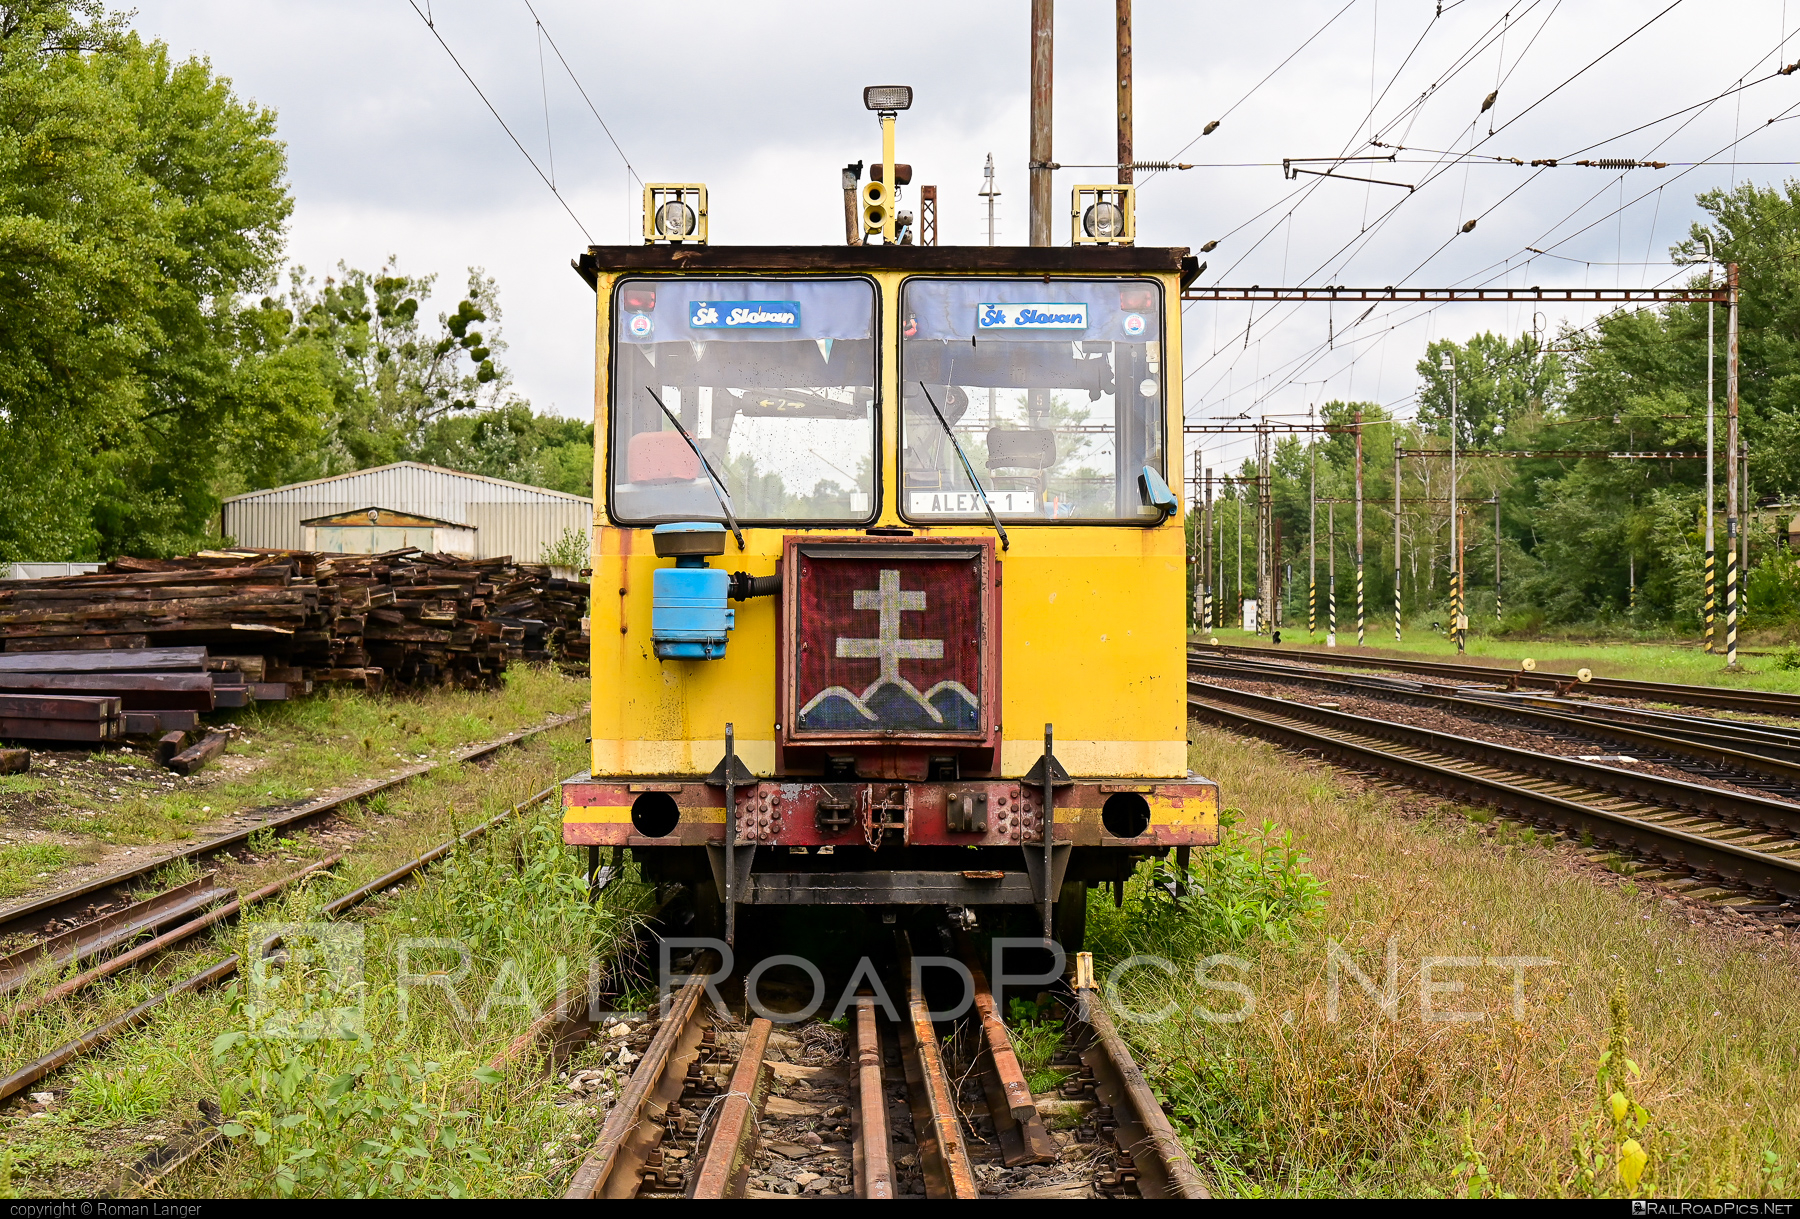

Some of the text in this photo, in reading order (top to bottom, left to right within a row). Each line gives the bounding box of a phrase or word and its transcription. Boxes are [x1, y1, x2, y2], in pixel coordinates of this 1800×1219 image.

[692, 301, 795, 326] Šk Slovan
[980, 304, 1083, 327] Šk Slovan
[777, 399, 786, 411] 2
[932, 494, 979, 511] ALEX
[1005, 494, 1012, 511] 1
